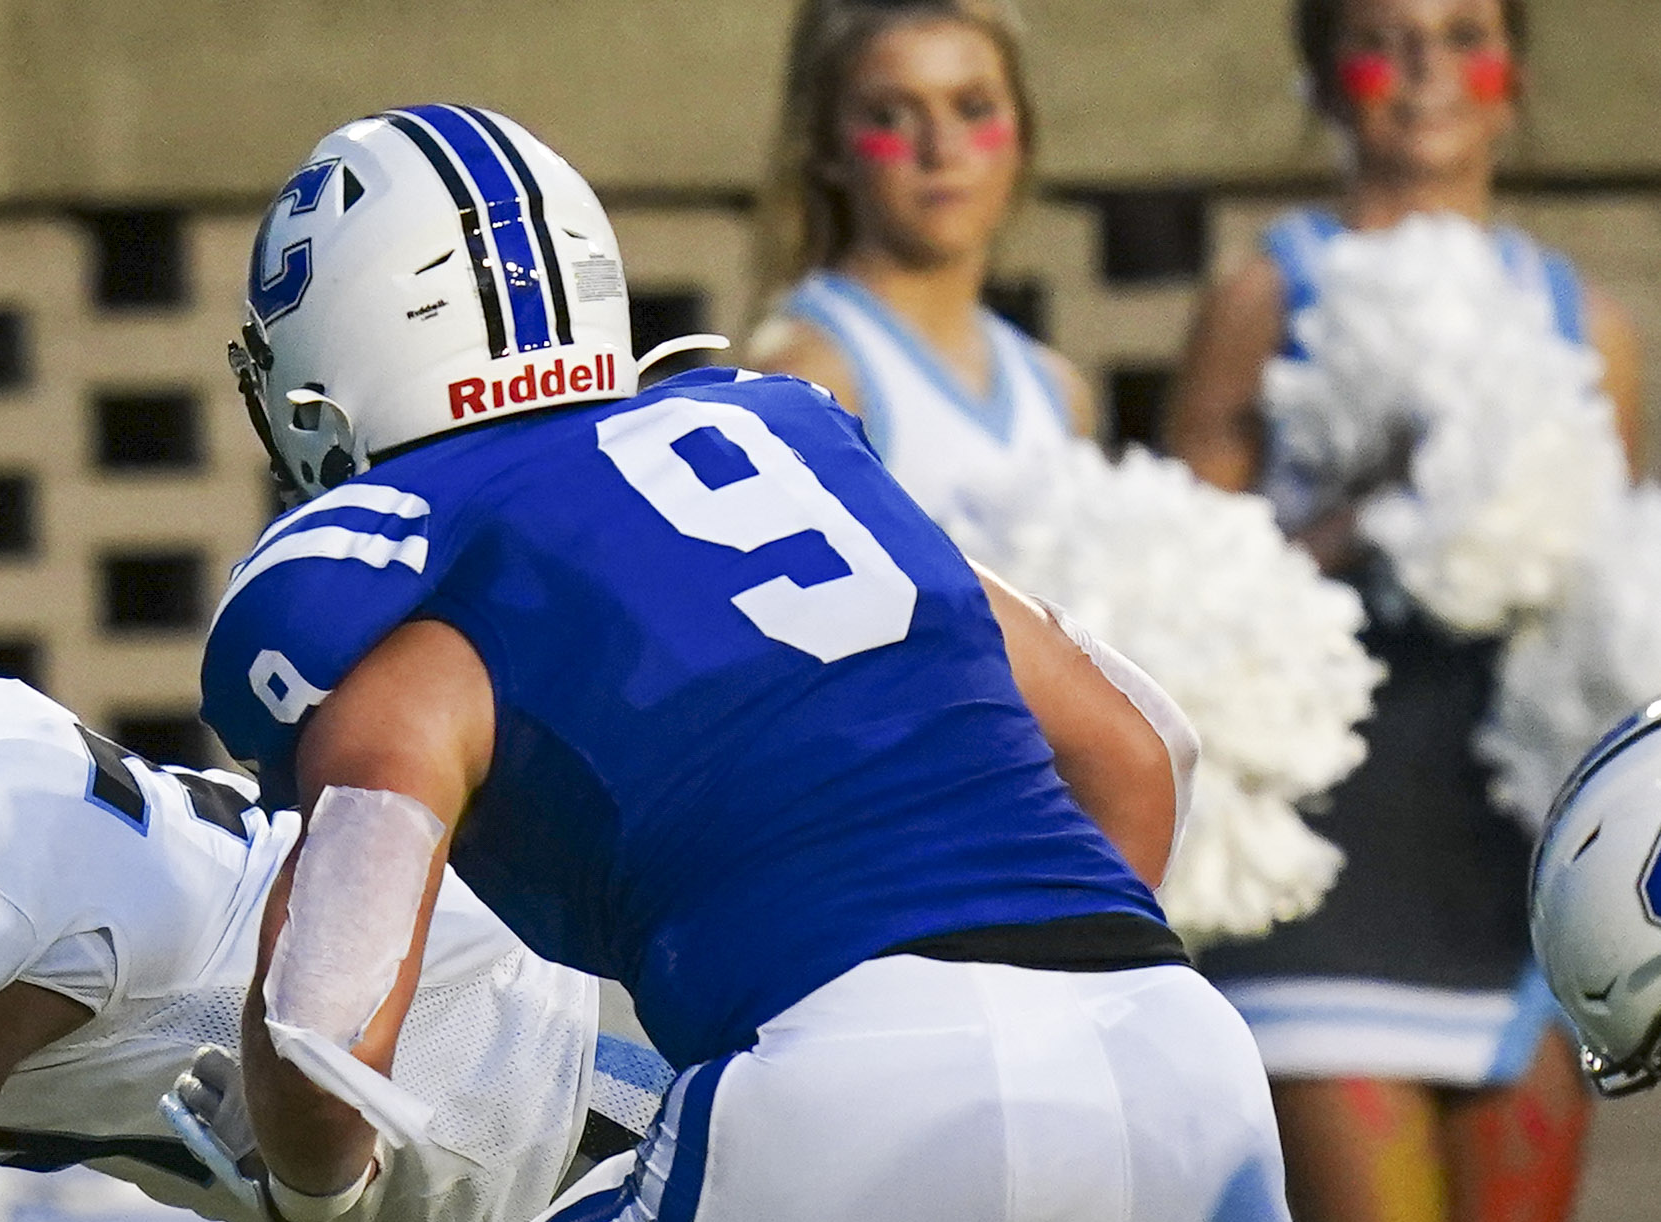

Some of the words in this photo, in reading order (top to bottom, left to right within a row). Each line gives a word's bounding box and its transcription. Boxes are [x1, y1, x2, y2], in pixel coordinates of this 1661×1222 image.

[248, 157, 341, 327] C
[448, 354, 615, 420] Riddell
[596, 397, 918, 664] 9
